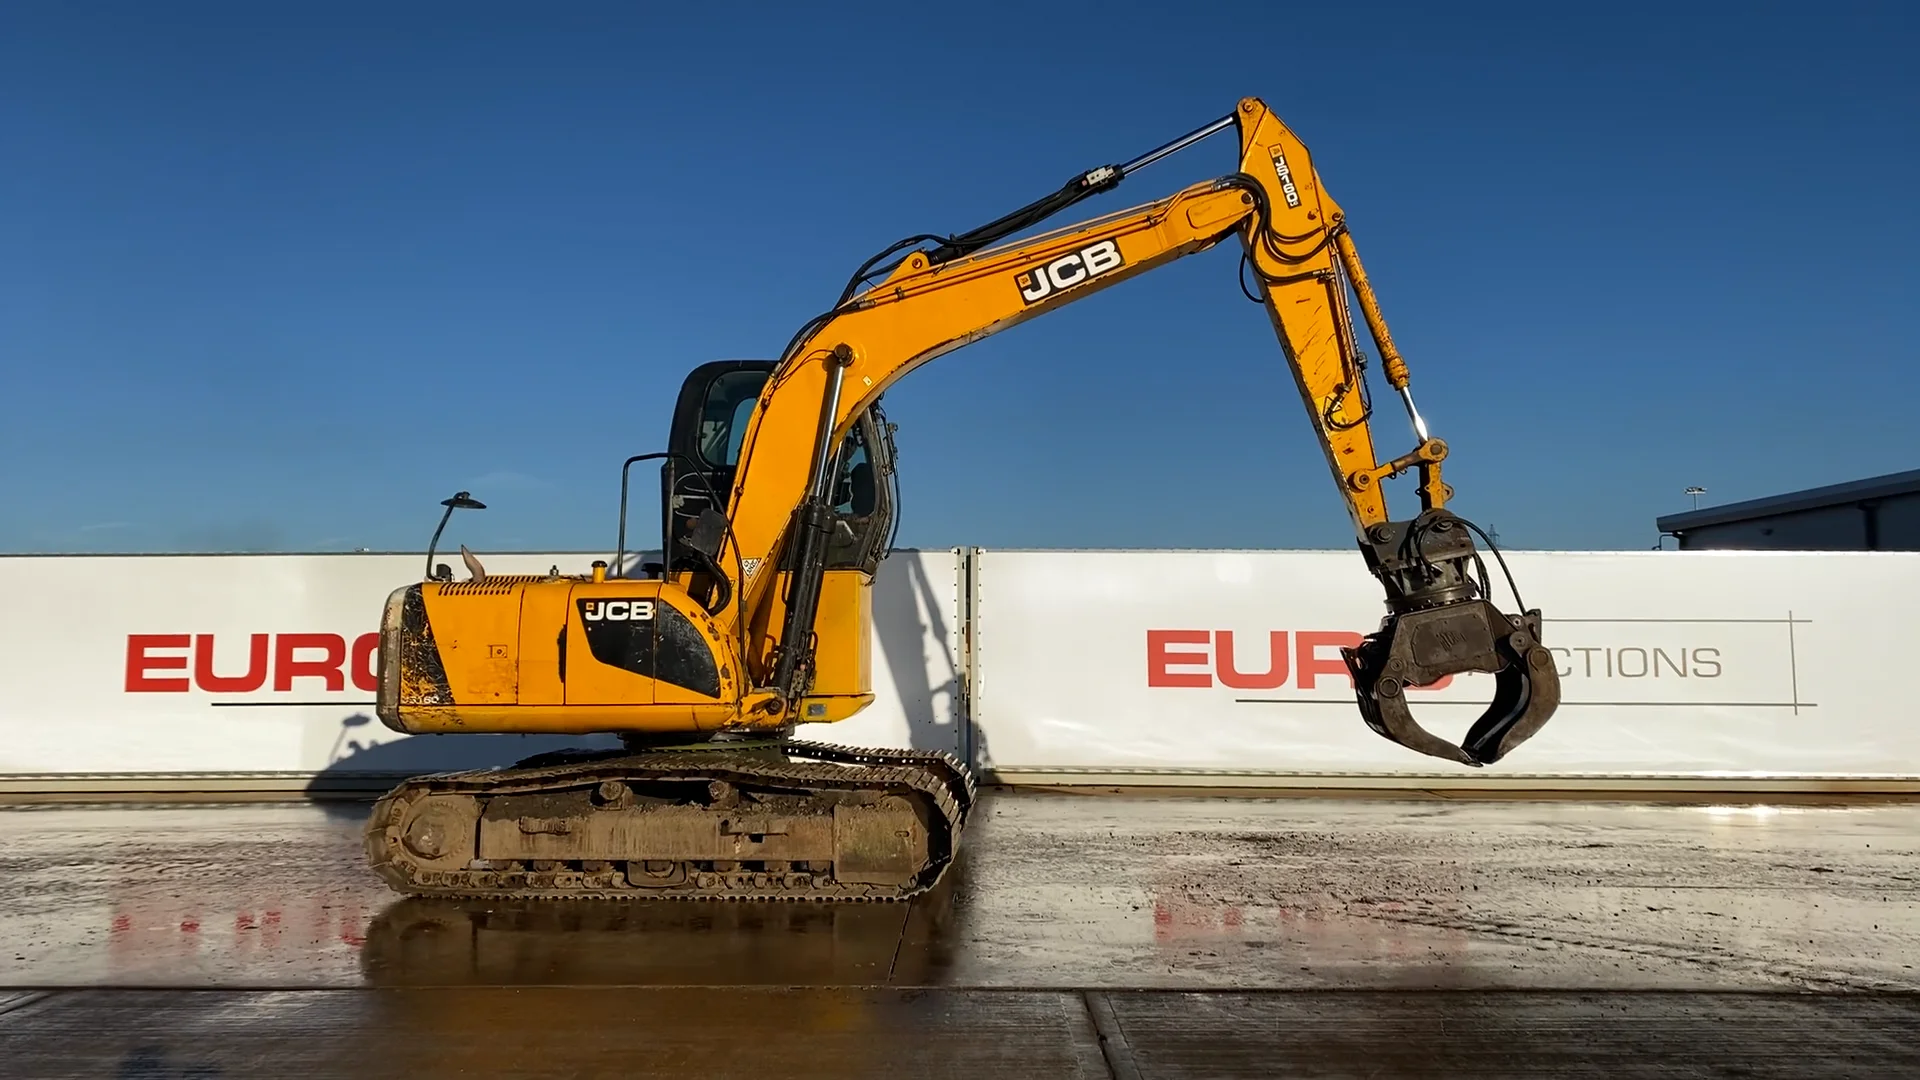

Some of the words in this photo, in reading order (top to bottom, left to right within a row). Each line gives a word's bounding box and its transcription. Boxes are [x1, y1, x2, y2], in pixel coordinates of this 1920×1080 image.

[1275, 156, 1298, 203] JS160
[1023, 241, 1121, 301] JCB
[585, 601, 654, 620] JCB
[1147, 629, 1454, 690] EUR
[1467, 647, 1722, 678] CTIONS
